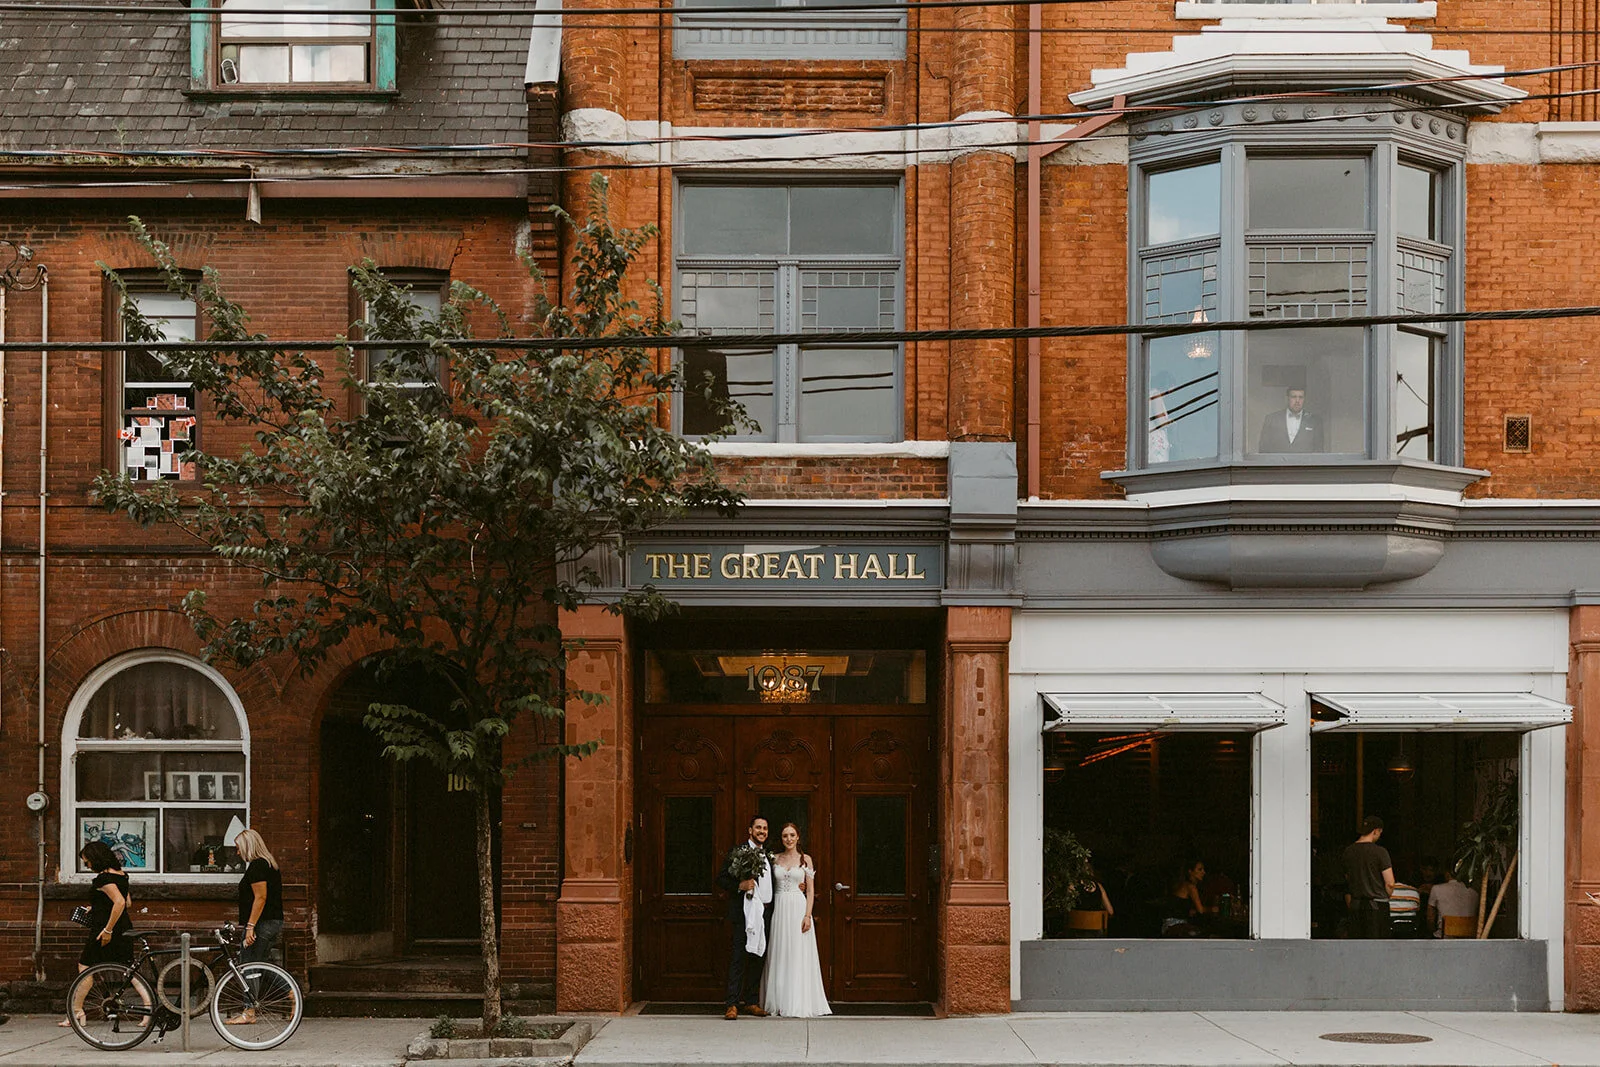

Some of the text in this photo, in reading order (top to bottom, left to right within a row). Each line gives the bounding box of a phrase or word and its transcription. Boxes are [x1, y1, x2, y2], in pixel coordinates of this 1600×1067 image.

[645, 553, 926, 579] THE GREAT HALL
[746, 664, 825, 691] 1087
